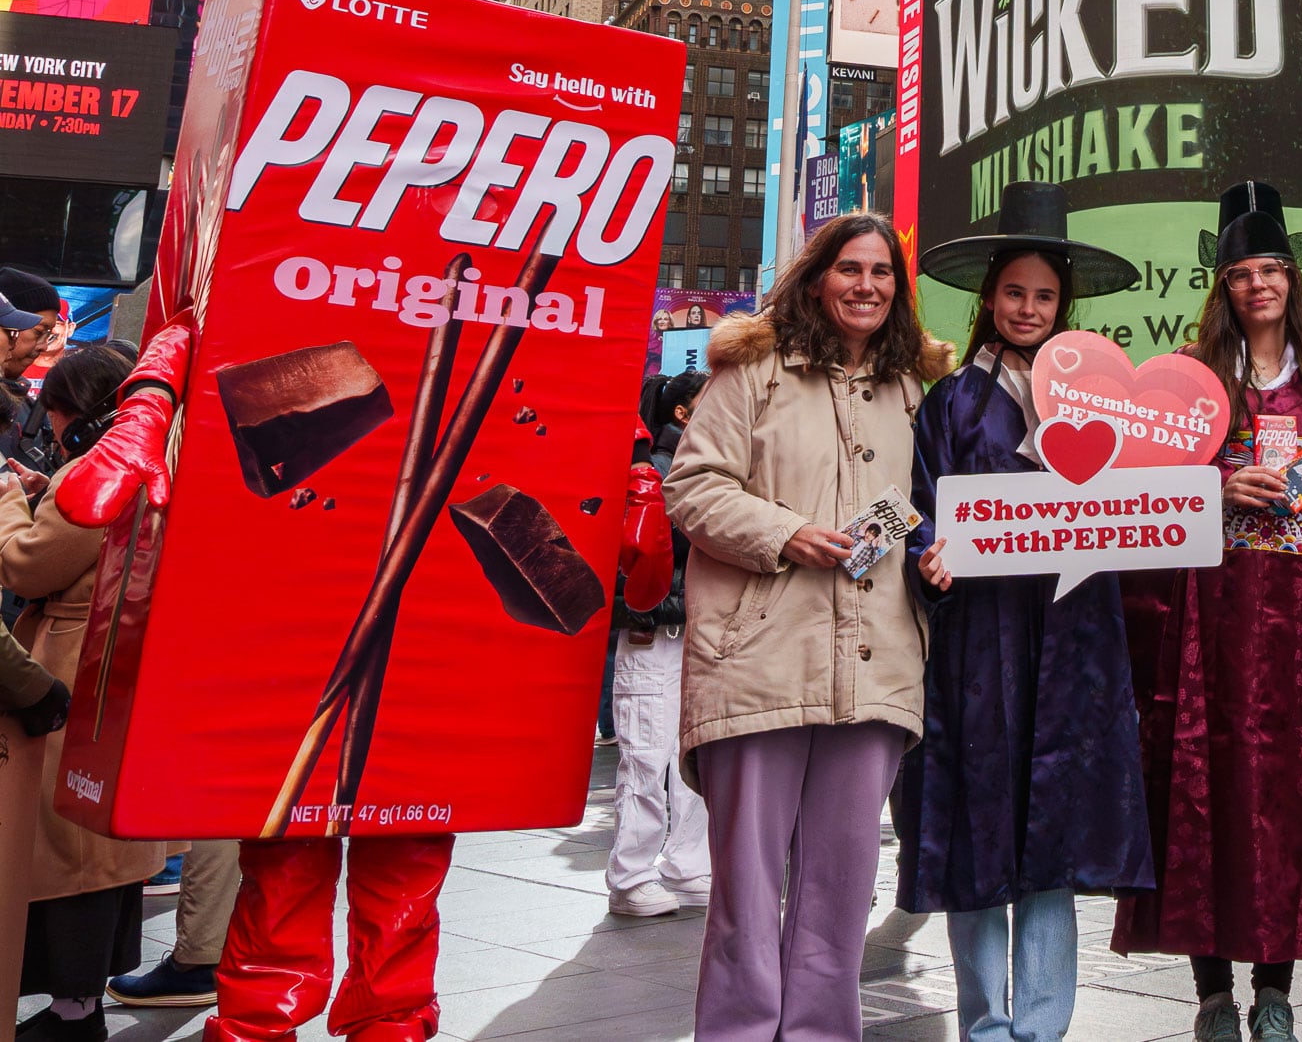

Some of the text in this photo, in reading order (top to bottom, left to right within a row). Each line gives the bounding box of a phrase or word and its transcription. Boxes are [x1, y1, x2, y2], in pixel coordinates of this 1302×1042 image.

[24, 55, 67, 76] YORK
[70, 60, 107, 80] CITY
[508, 63, 657, 110] Say hello with
[832, 67, 874, 80] KEVANI
[0, 79, 140, 118] EMBER 17
[899, 25, 920, 157] INSIDE!
[52, 116, 101, 136] 7:30PM
[226, 69, 677, 266] PEPERO
[969, 103, 1206, 224] MILKSHAKE
[273, 256, 605, 339] original
[1049, 380, 1212, 436] November 11th
[1056, 402, 1201, 453] PERO DAY
[1255, 429, 1298, 447] PEPERO
[870, 499, 911, 540] PEPERO
[954, 492, 1206, 523] #Showyourlove
[971, 523, 1188, 556] withPEPERO
[66, 768, 104, 804] original
[290, 805, 323, 823] NET
[326, 805, 354, 823] WT.
[358, 804, 378, 822] 47
[426, 804, 452, 824] Oz)
